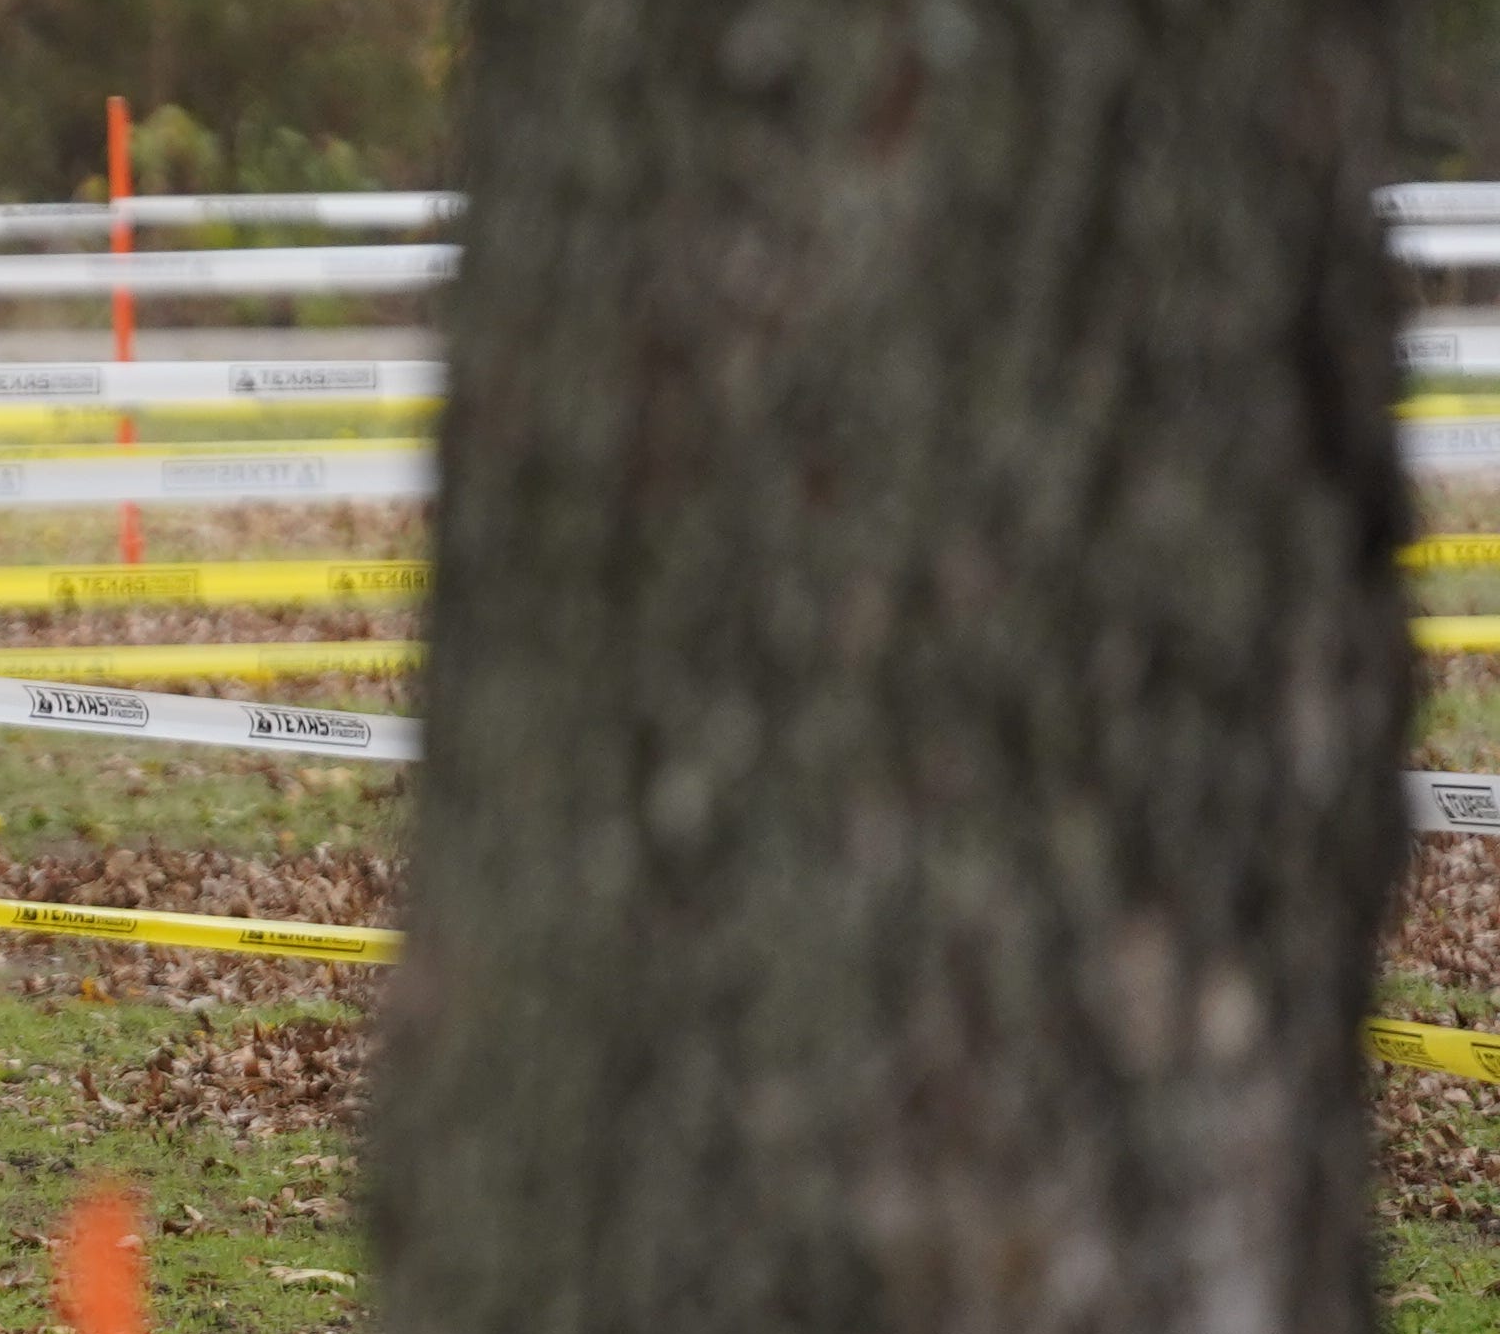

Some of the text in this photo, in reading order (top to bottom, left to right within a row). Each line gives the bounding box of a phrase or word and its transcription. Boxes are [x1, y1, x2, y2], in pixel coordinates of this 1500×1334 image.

[52, 691, 108, 717] TEXAS
[109, 708, 144, 720] SYNDICATE
[271, 711, 329, 736] TEXAS
[330, 728, 365, 739] SYNDICATE
